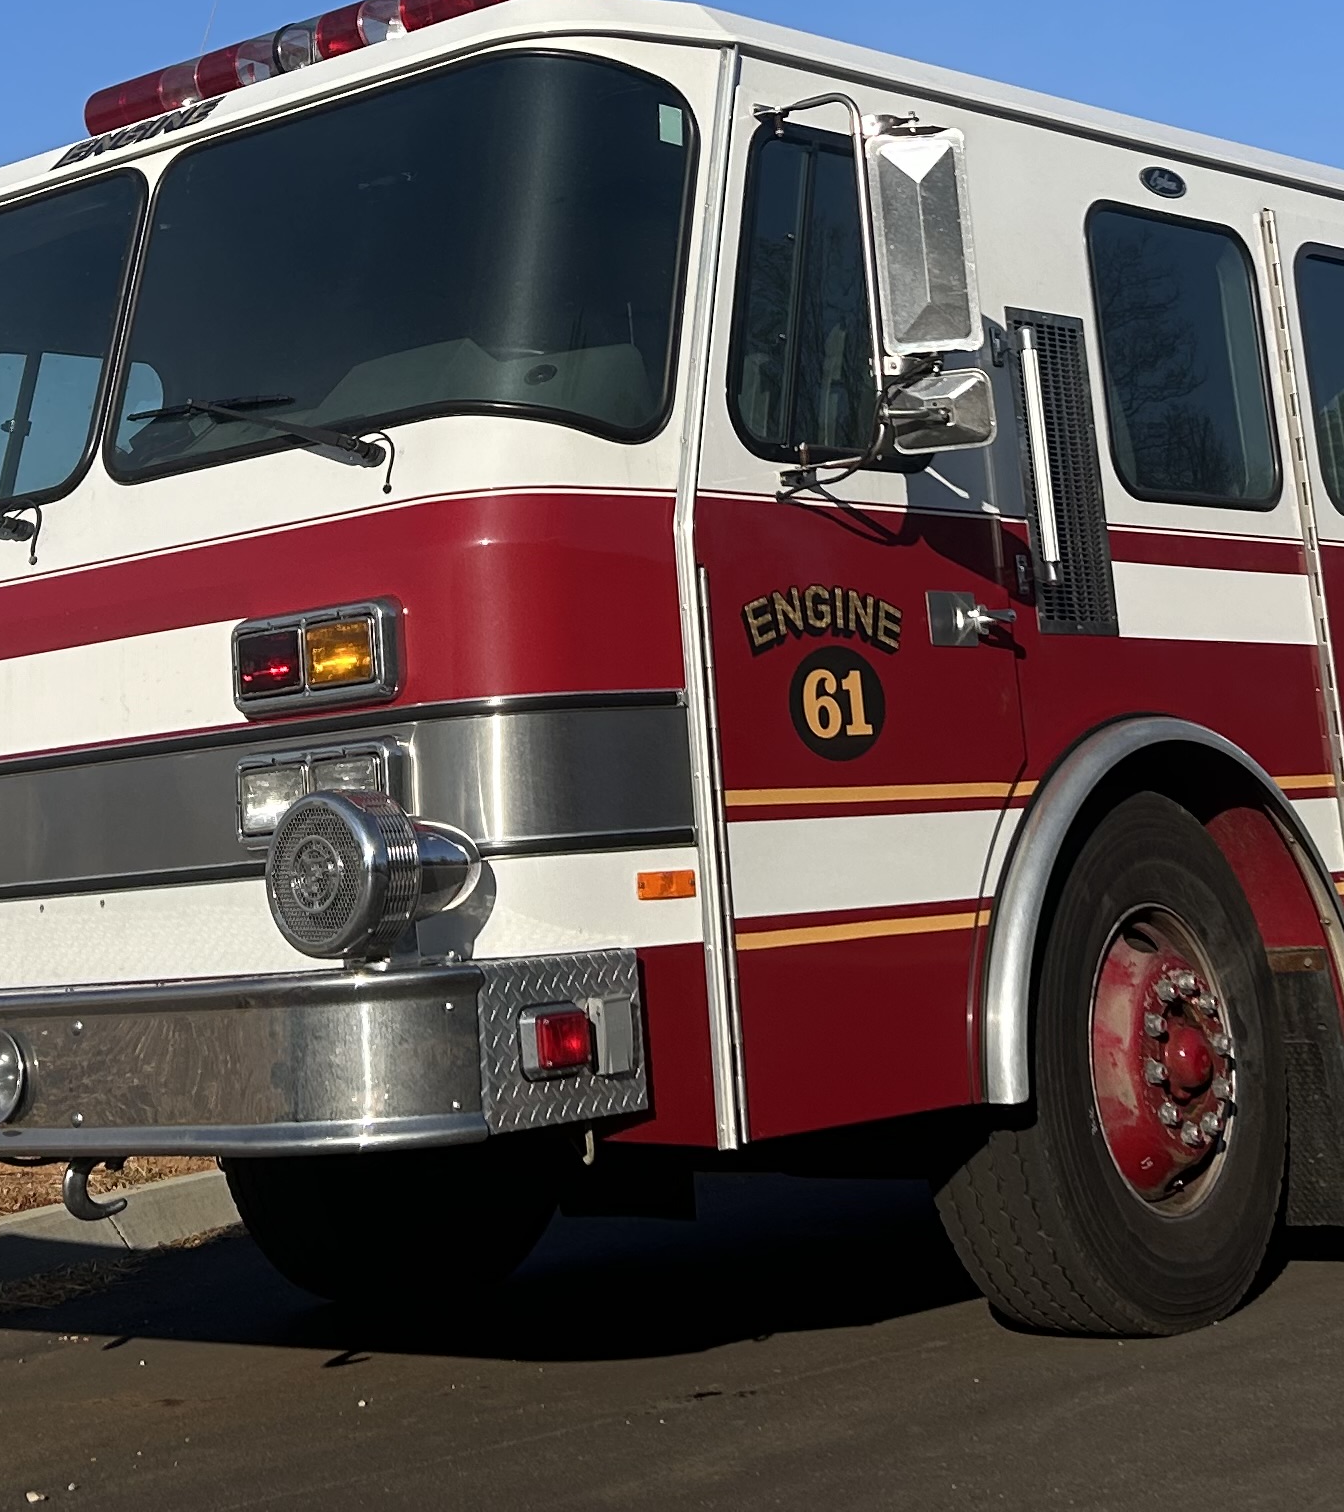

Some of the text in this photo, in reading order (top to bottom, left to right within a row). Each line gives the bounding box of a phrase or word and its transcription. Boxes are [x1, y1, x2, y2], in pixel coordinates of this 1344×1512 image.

[50, 95, 227, 171] ENGINE
[742, 584, 904, 655] ENGINE
[802, 668, 874, 739] 61
